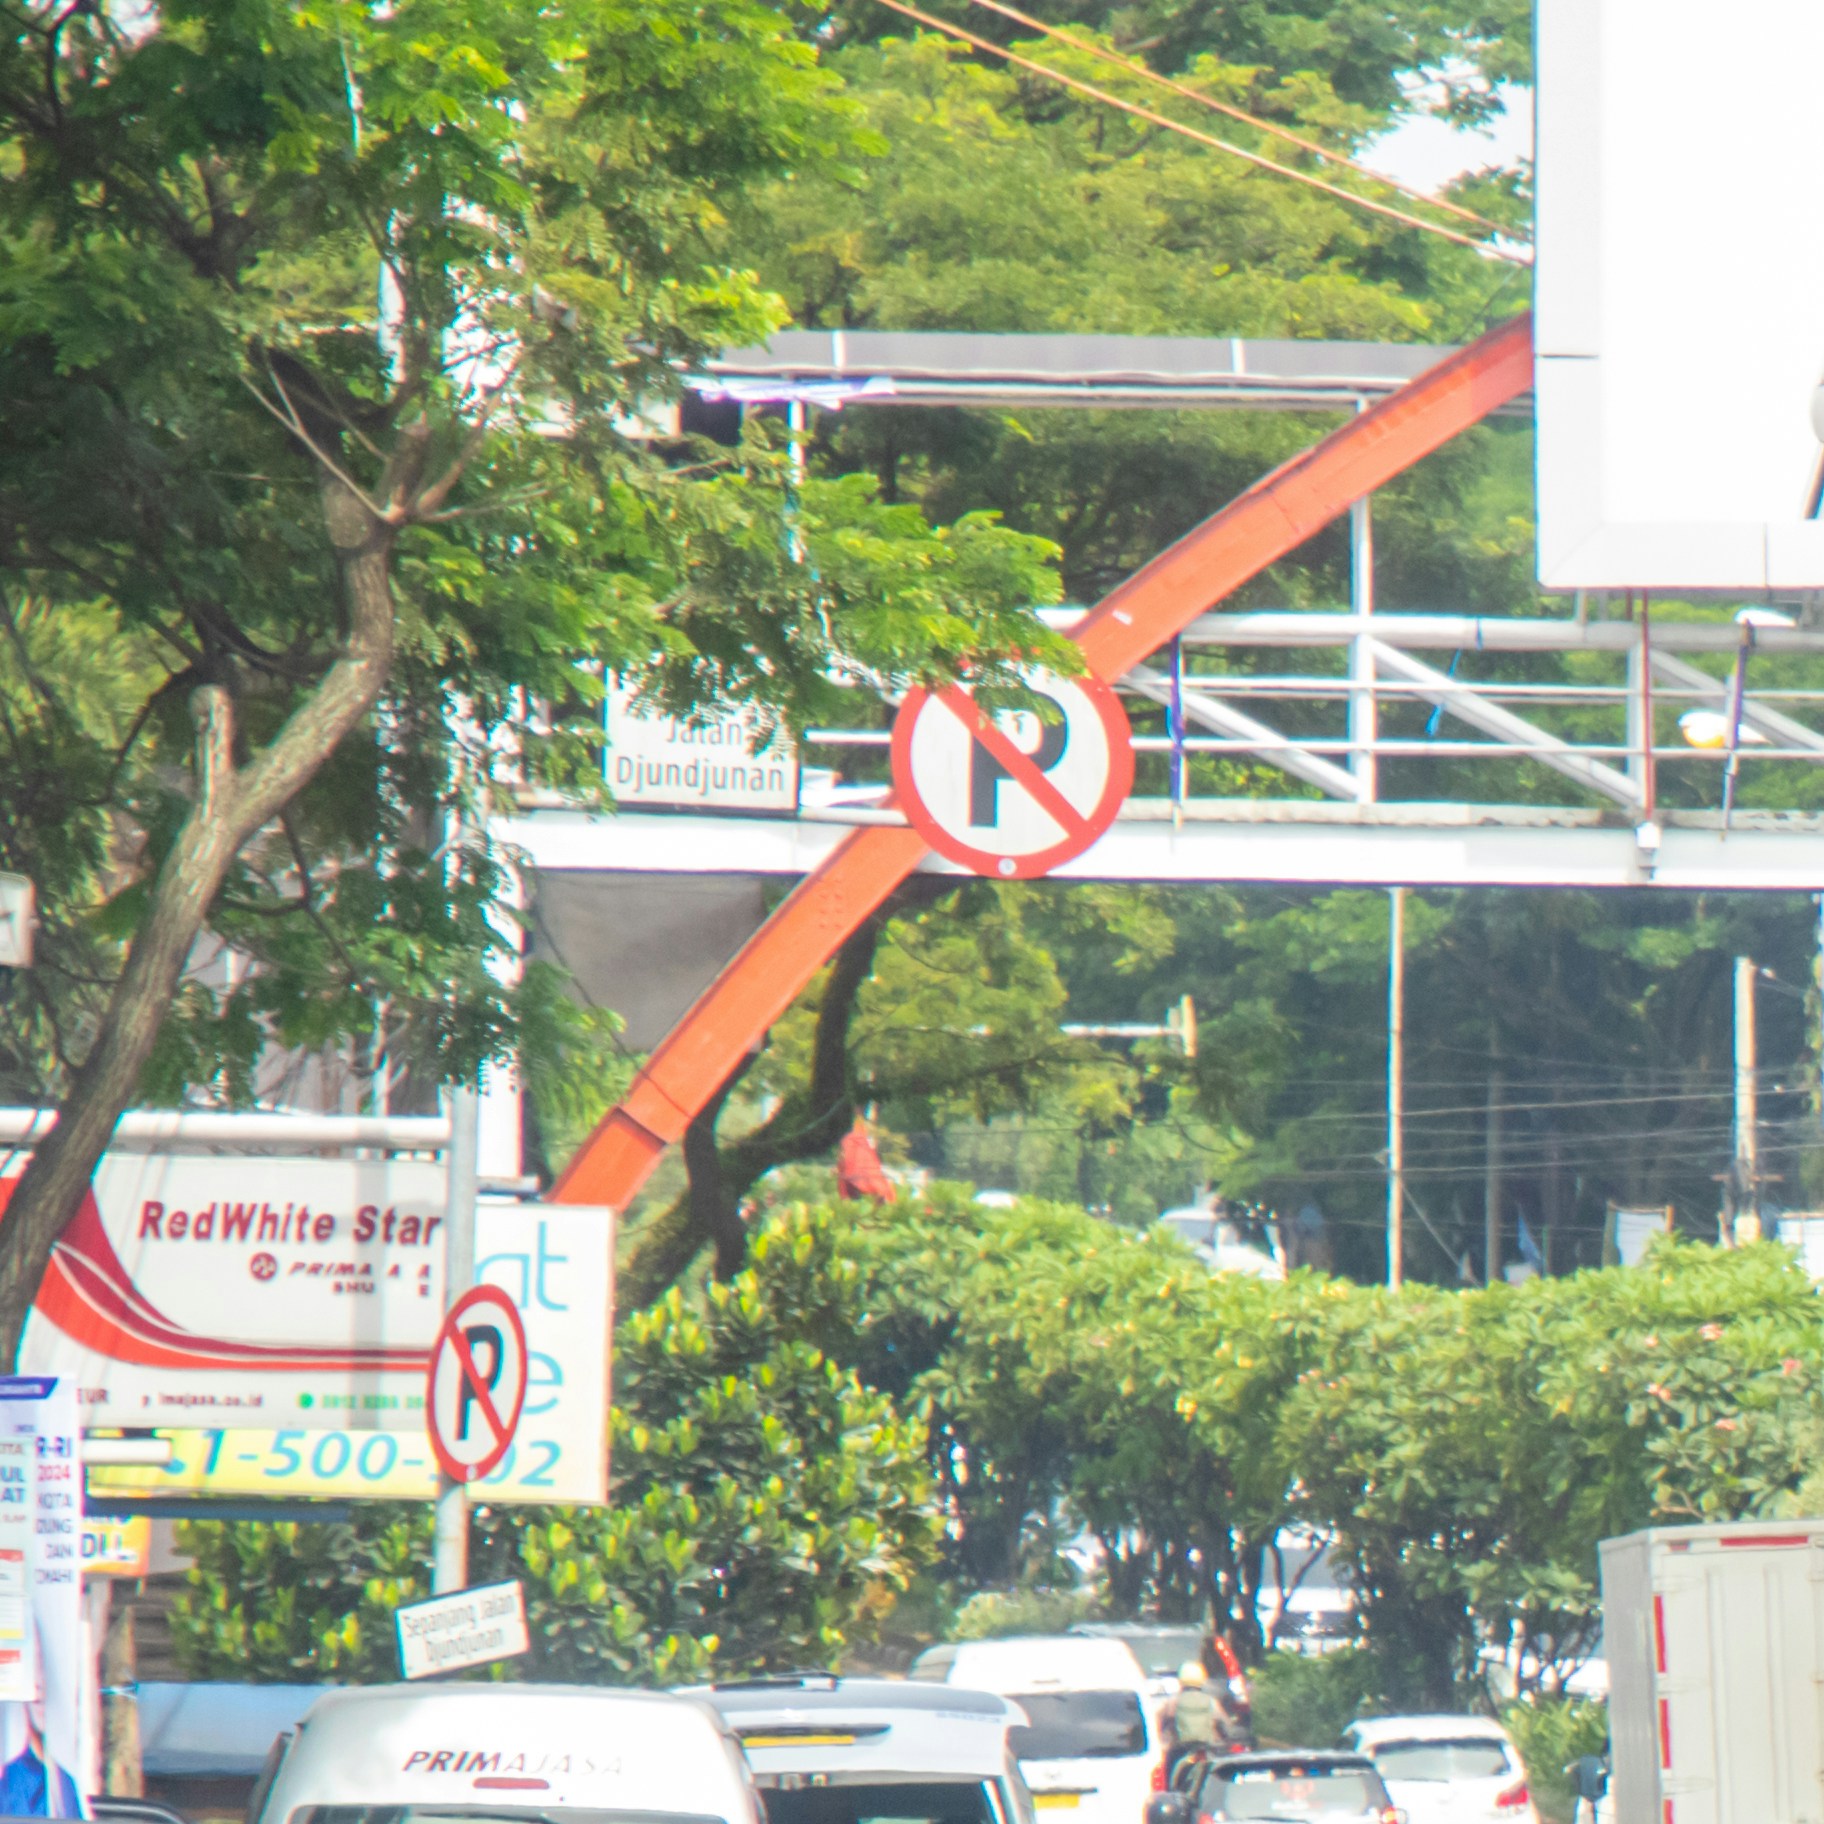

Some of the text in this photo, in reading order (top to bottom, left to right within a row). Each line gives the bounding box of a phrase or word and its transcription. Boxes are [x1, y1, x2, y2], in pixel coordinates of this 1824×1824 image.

[616, 755, 785, 797] Djundjunan
[138, 1200, 443, 1245] RedWhite Star
